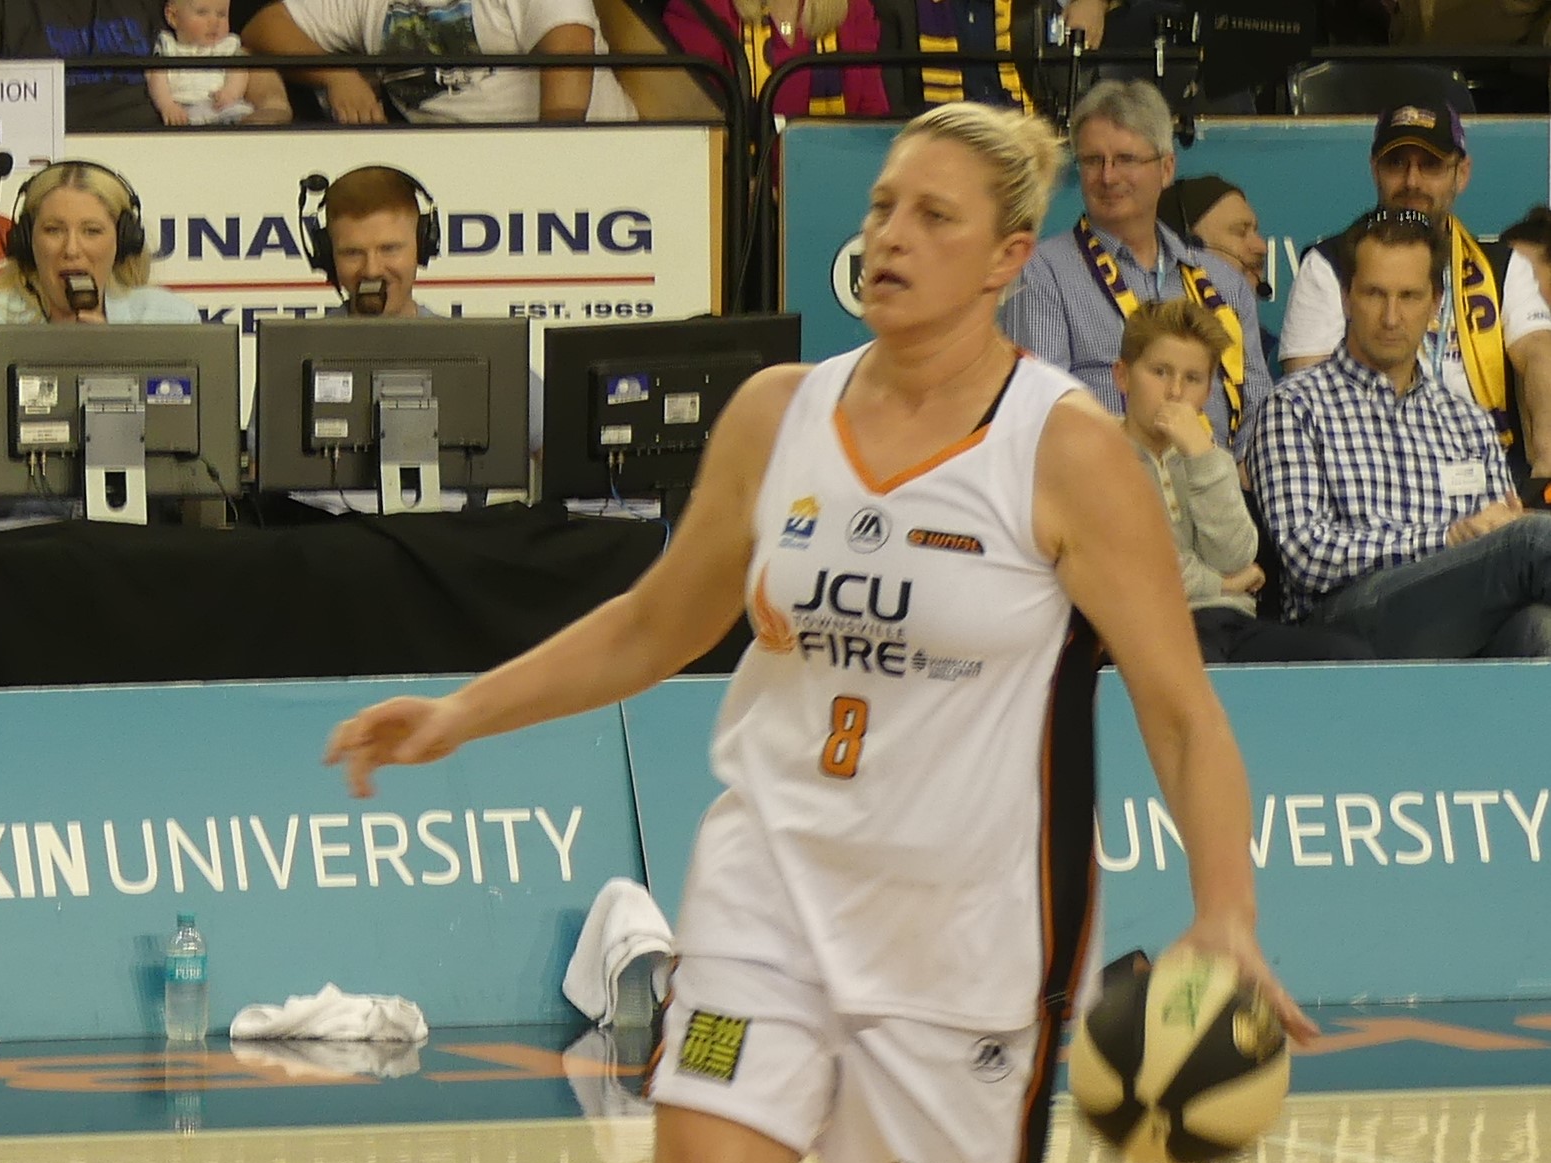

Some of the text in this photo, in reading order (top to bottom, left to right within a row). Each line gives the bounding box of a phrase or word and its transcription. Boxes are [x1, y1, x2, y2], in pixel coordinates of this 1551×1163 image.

[508, 300, 655, 319] EST. 1969
[792, 568, 914, 622] JCU
[798, 631, 908, 679] FIRE
[820, 695, 869, 779] 8
[103, 806, 583, 895] UNIVERSITY
[1093, 788, 1550, 873] UNVERSITY
